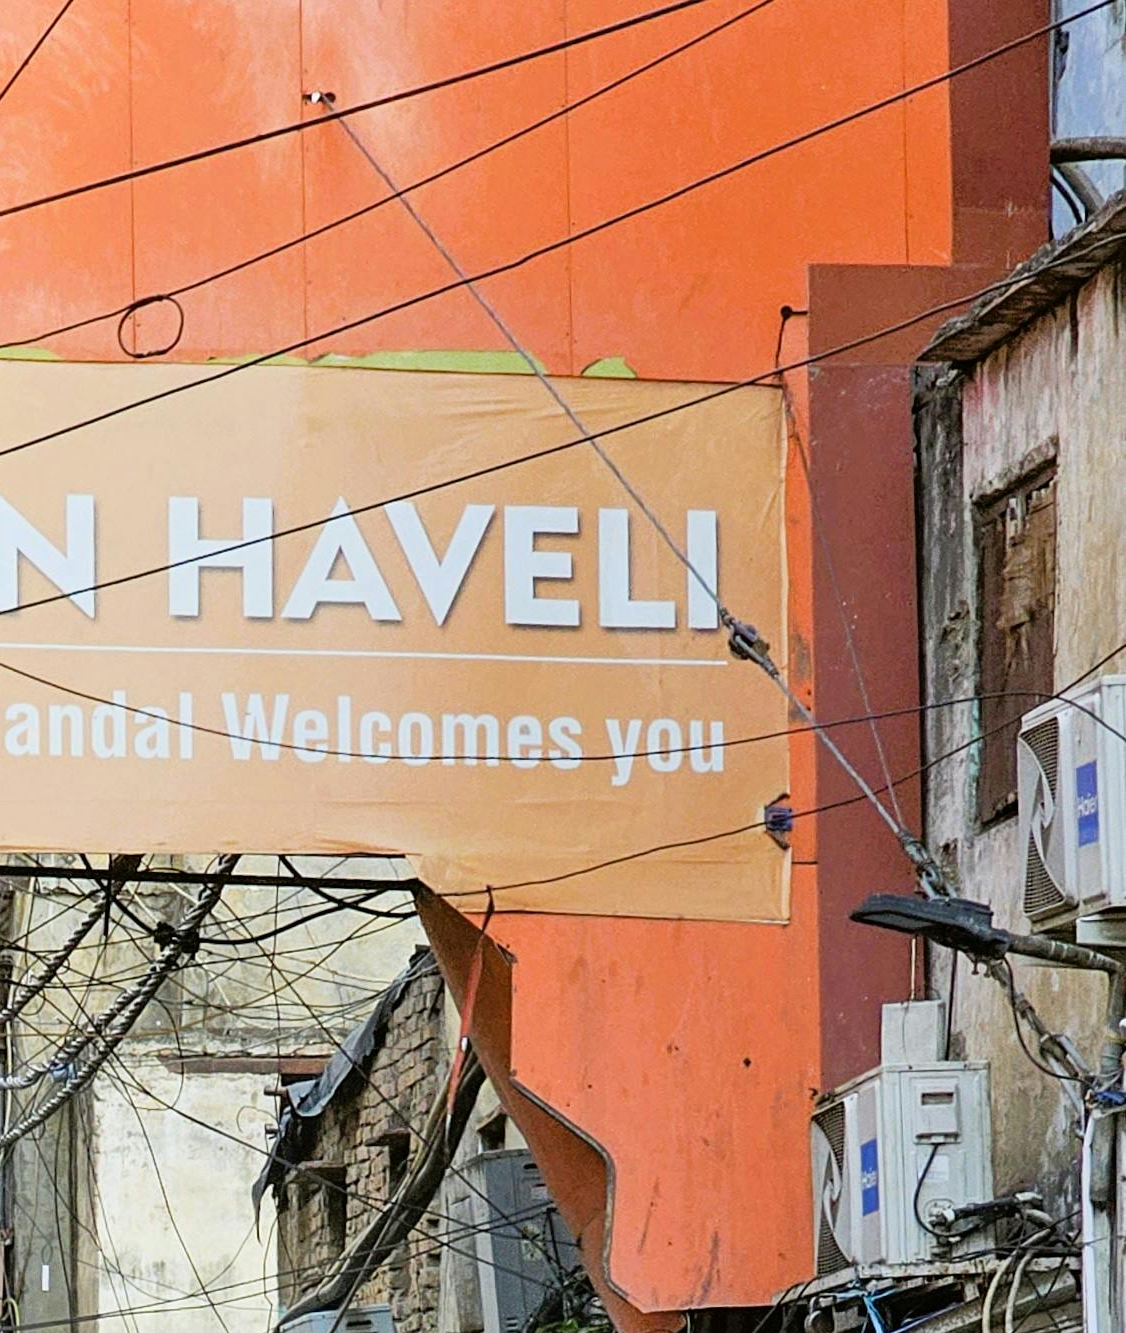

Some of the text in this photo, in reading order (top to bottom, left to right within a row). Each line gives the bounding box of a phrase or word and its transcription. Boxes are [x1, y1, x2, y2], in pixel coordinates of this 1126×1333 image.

[169, 496, 720, 630] HAVELI
[221, 692, 583, 770] Welcomes
[606, 717, 725, 787] you
